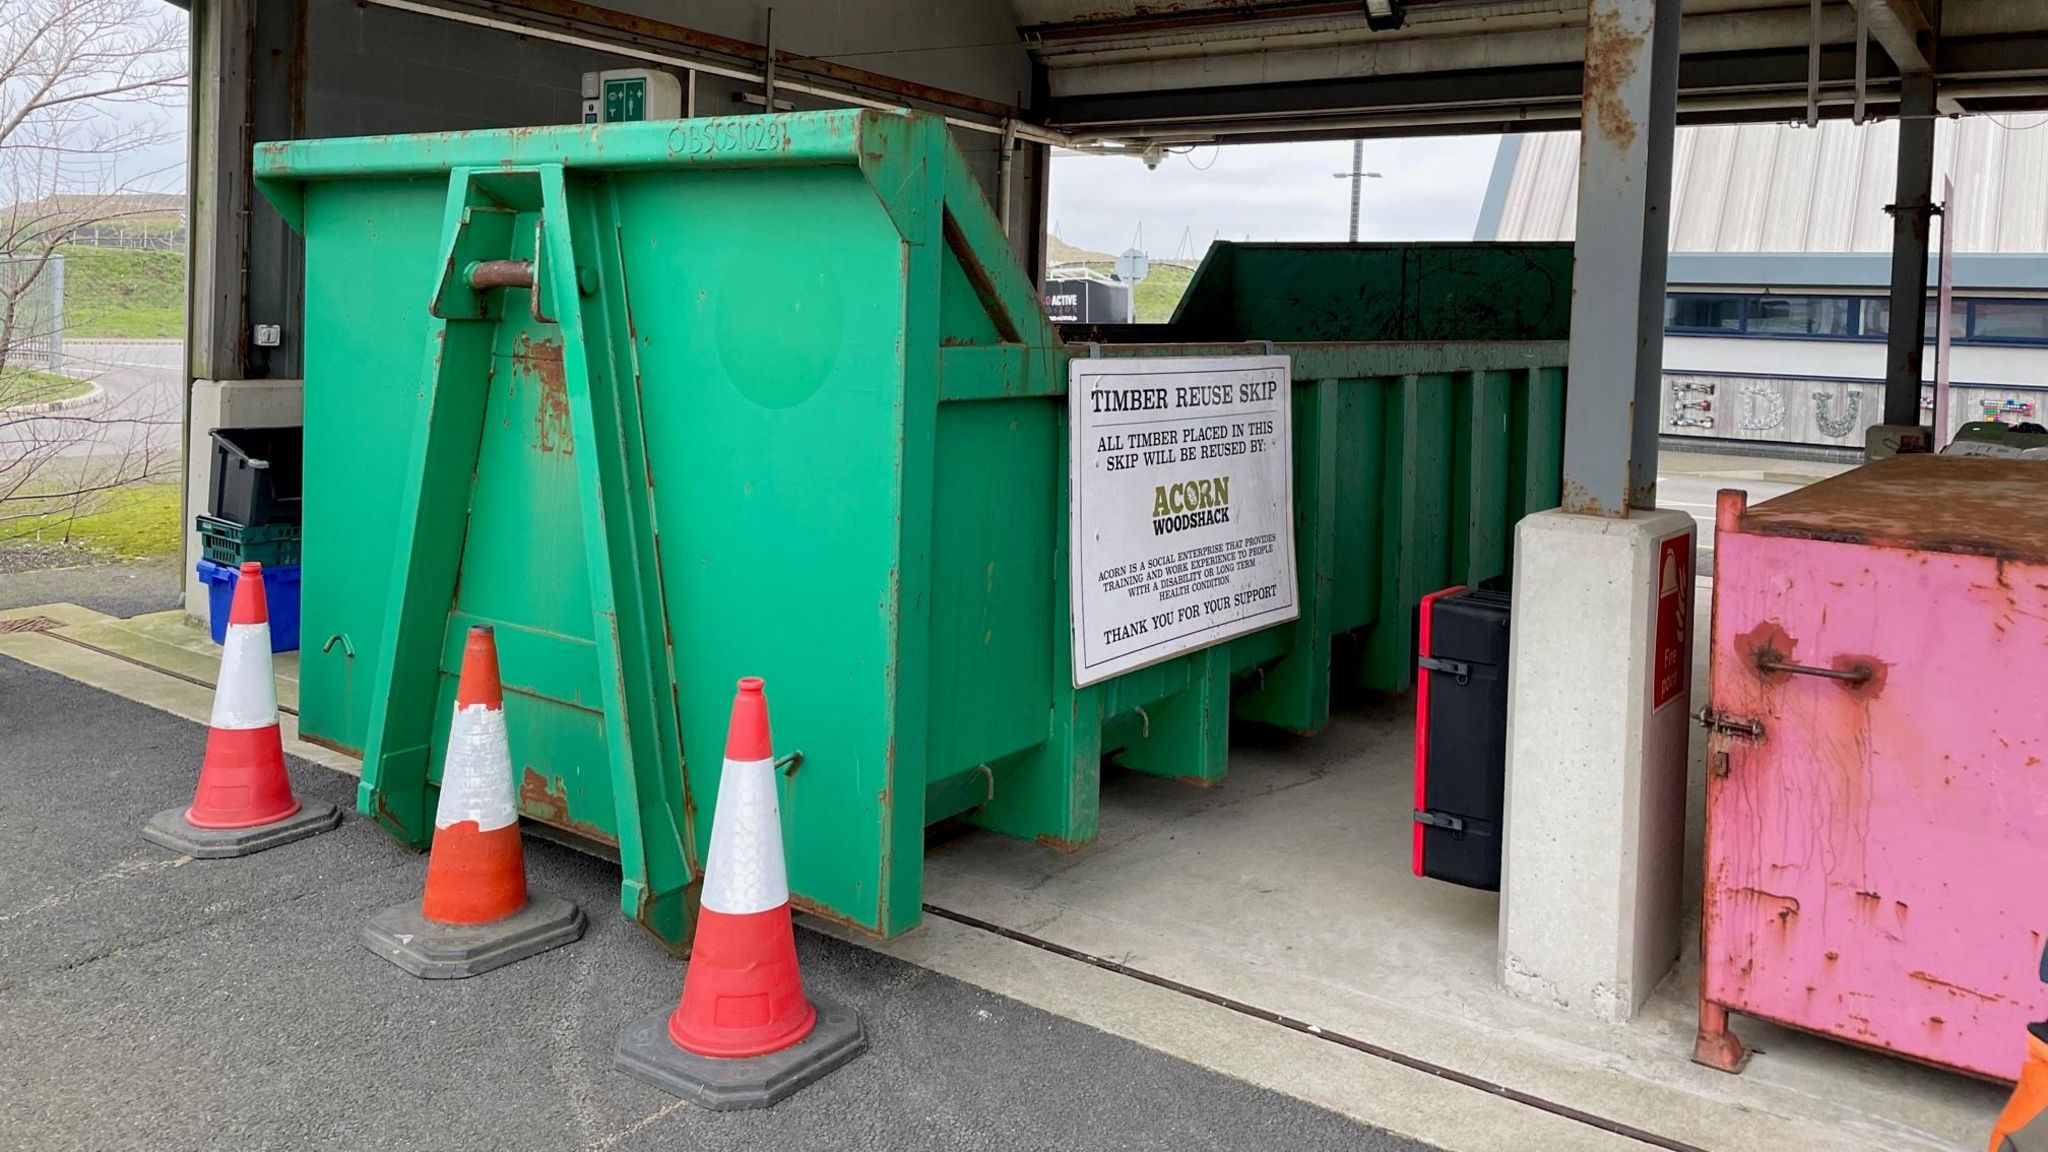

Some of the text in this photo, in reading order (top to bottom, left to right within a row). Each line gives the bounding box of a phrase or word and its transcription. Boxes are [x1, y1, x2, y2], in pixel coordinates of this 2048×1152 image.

[1091, 380, 1278, 413] TIMBER REUSE SKIP
[1097, 420, 1274, 452] ALL TIMBER PLACED IN THIS
[1106, 438, 1267, 472] SKIP WILL BE REUSED BY:
[1152, 476, 1229, 518] ACORN
[1152, 507, 1230, 536] WOODSHACK
[1098, 533, 1277, 582] ACORN IS A SOCIAL ENTERPRISE THAT PROVIDES
[1102, 543, 1274, 593] TRAINING AND WORK EXPERIENCE TO PEOPLE
[1127, 558, 1256, 598] WITH A DISABILITY OR LONG TERM
[1159, 575, 1231, 602] HEALTH CONDITION
[1103, 584, 1278, 645] THANK YOU FOR YOUR SUPPORT
[1664, 648, 1678, 669] Fire
